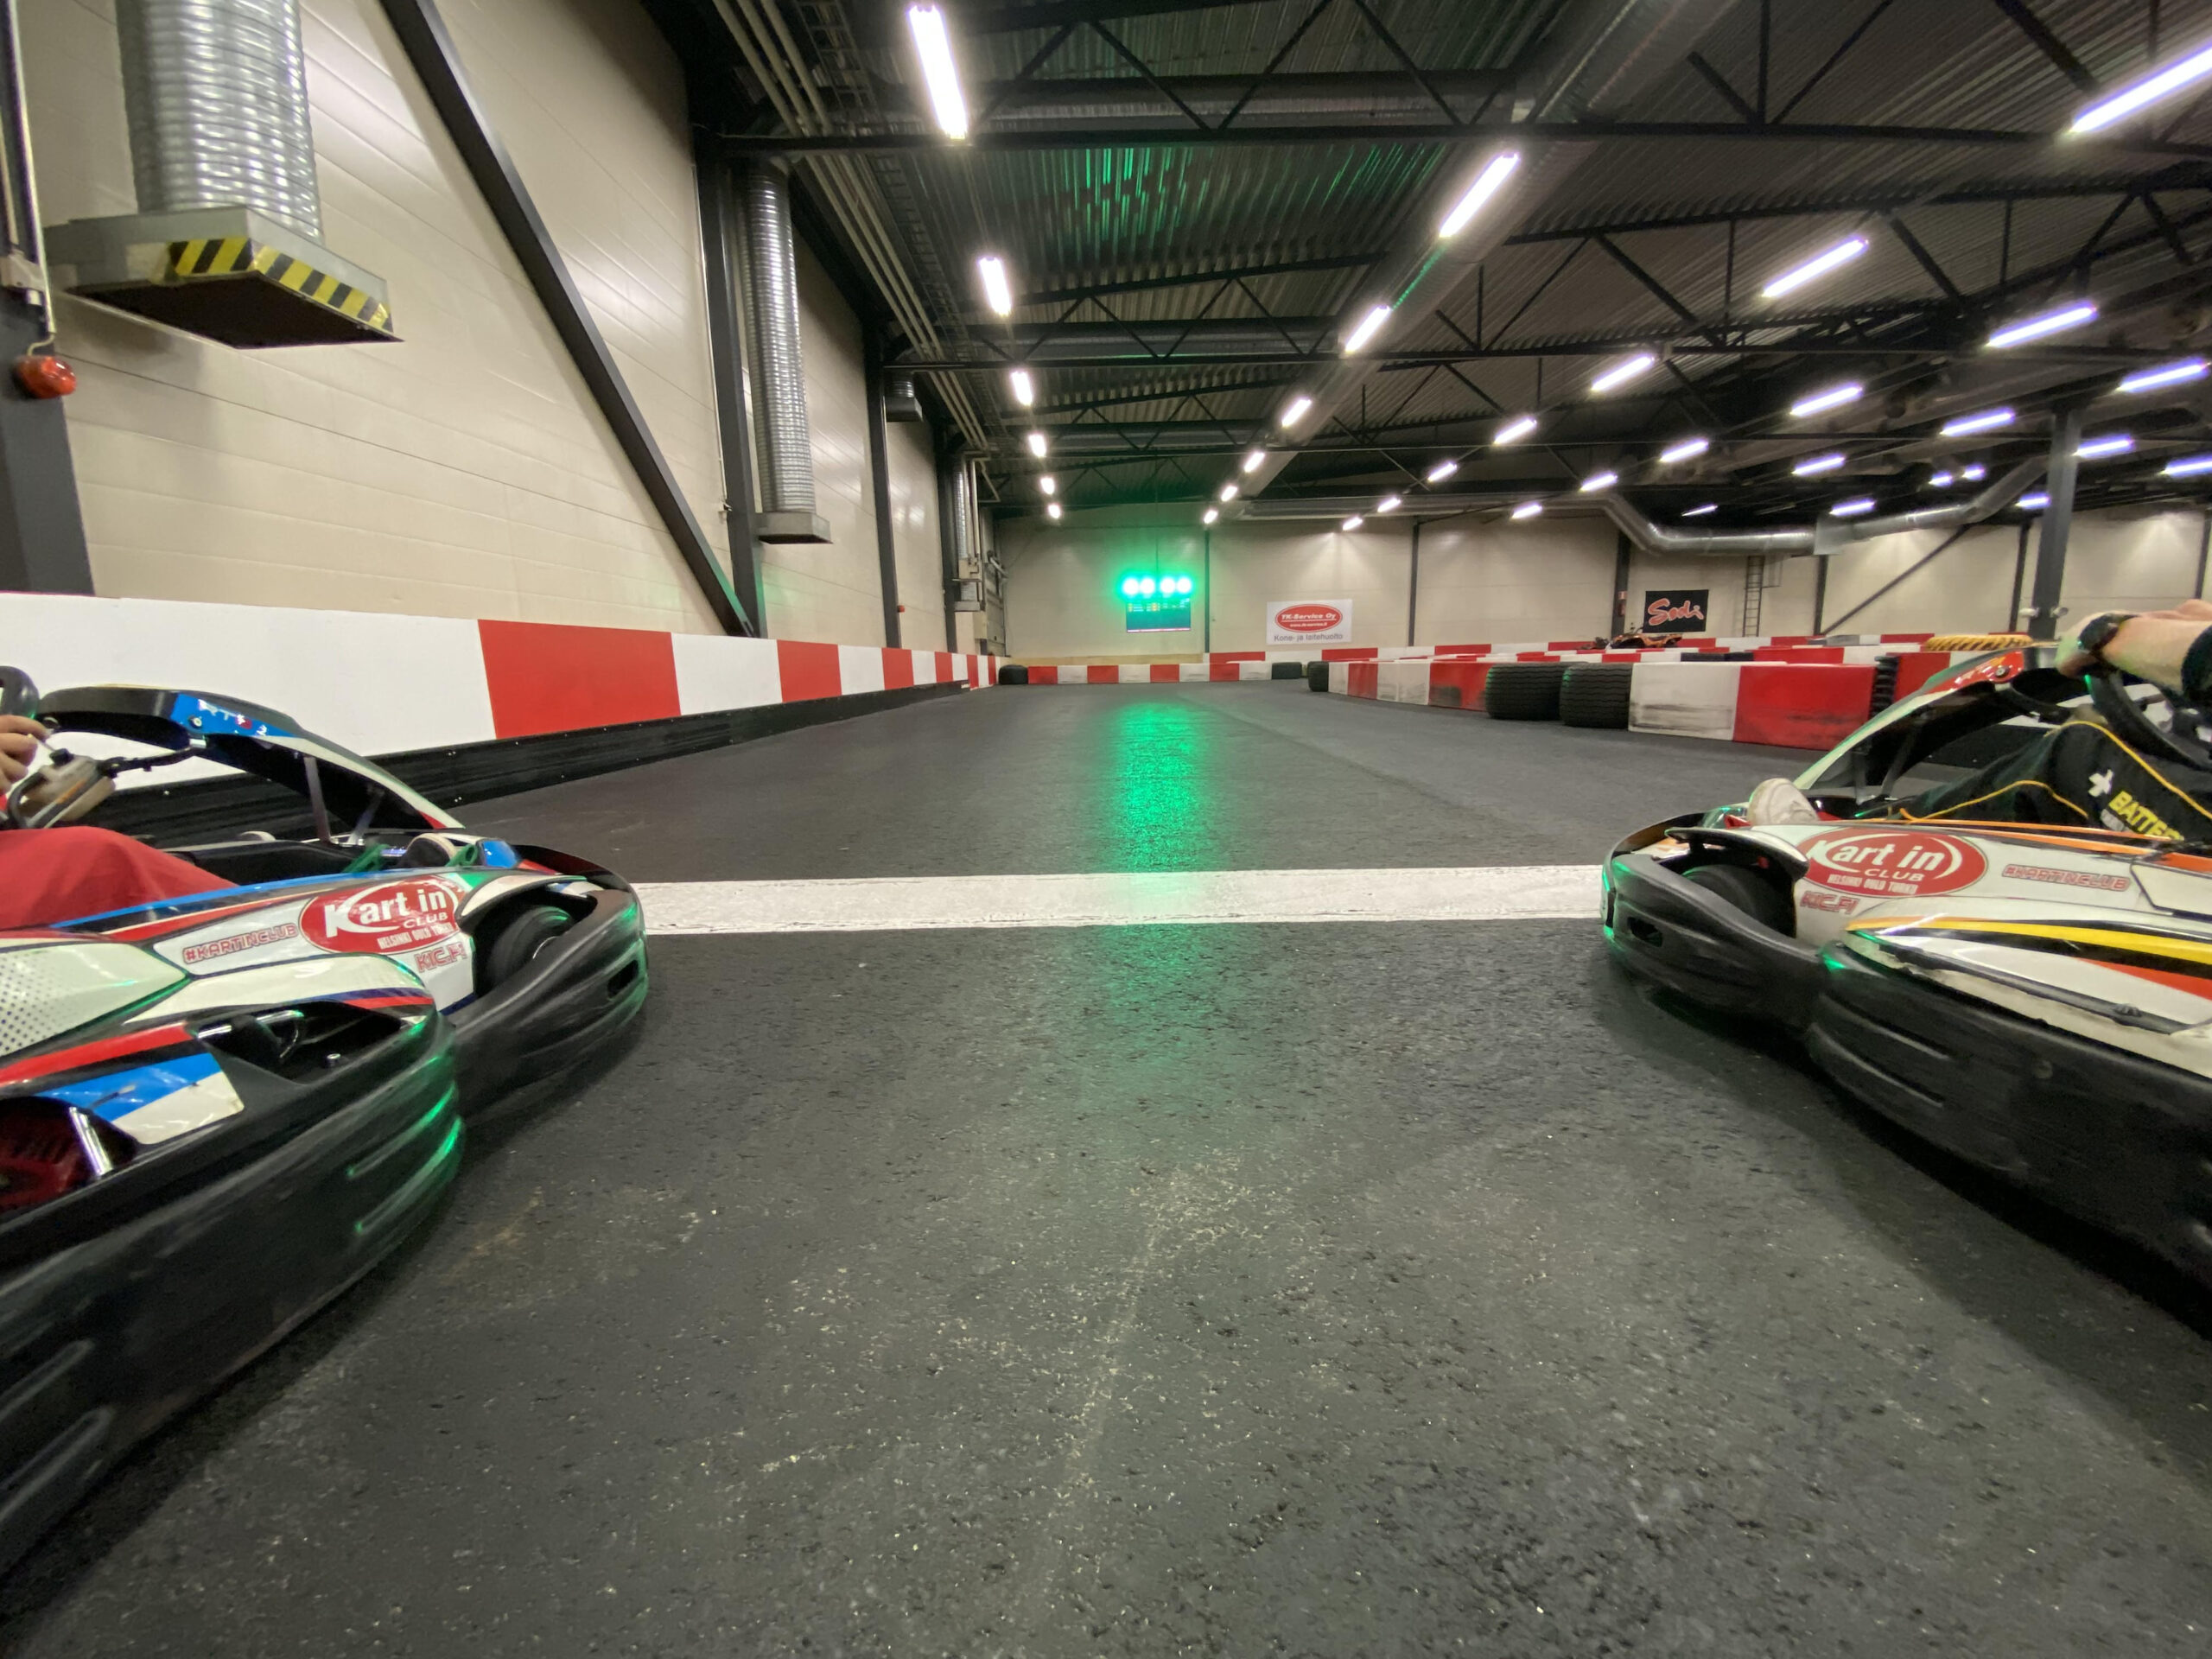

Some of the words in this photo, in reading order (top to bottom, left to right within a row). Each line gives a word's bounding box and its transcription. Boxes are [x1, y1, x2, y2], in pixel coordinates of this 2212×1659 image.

[1648, 597, 1704, 626] Sodi
[1306, 632, 1343, 641] laitehuolto
[1806, 834, 1896, 873] Kart
[1897, 845, 1945, 872] in
[1864, 868, 1925, 882] CLUB
[2002, 863, 2131, 892] #KARTINCLUB
[324, 883, 410, 938] Kart
[417, 888, 448, 912] in
[403, 912, 448, 930] CLUB
[183, 923, 299, 965] #KARTINCLUB
